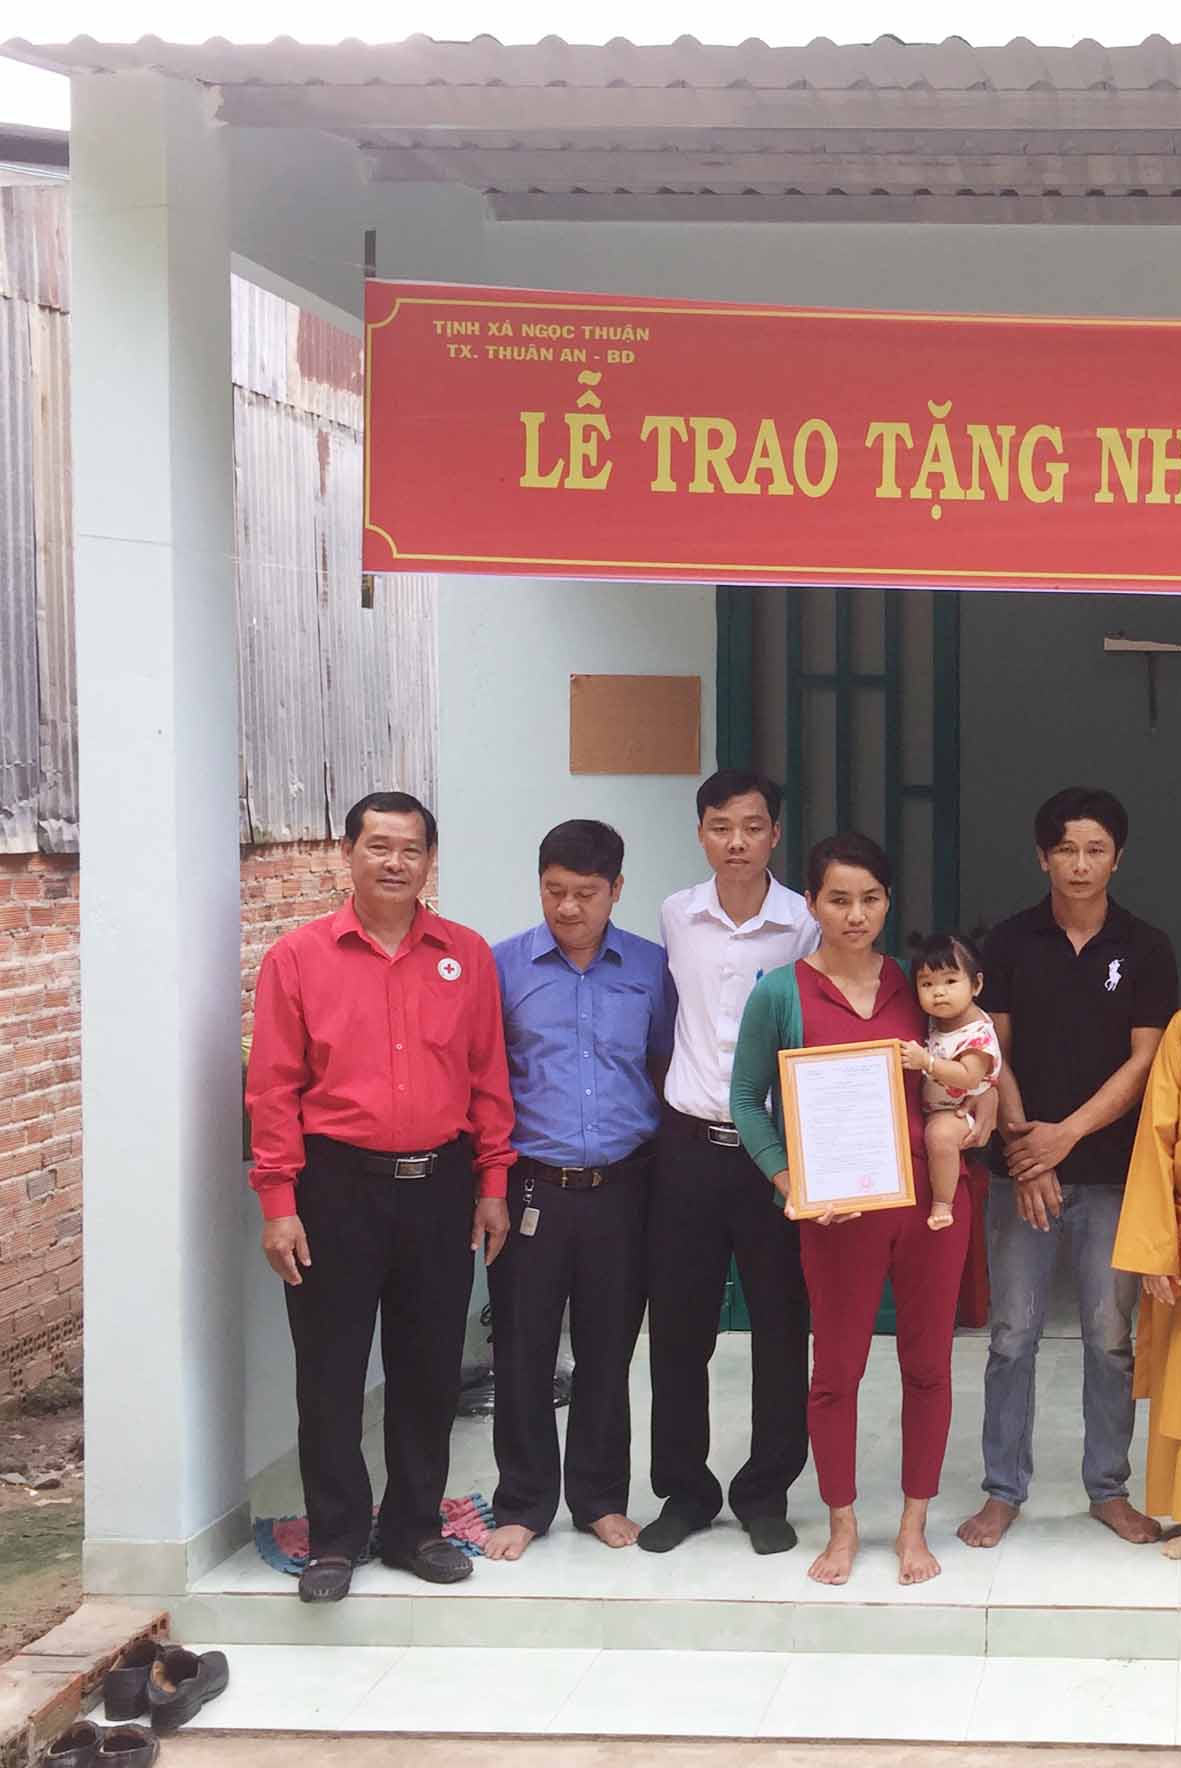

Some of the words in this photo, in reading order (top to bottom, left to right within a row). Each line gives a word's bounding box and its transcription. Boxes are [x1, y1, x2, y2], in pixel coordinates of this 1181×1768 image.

[433, 320, 480, 337] TỊNH
[521, 324, 575, 340] NGỌC
[581, 324, 649, 343] THUẬN
[447, 344, 478, 359] TX.
[560, 348, 586, 362] AN
[607, 350, 635, 363] BD
[520, 370, 612, 490] LỄ
[640, 416, 839, 497] TRAO
[865, 400, 1069, 520] TẶNG
